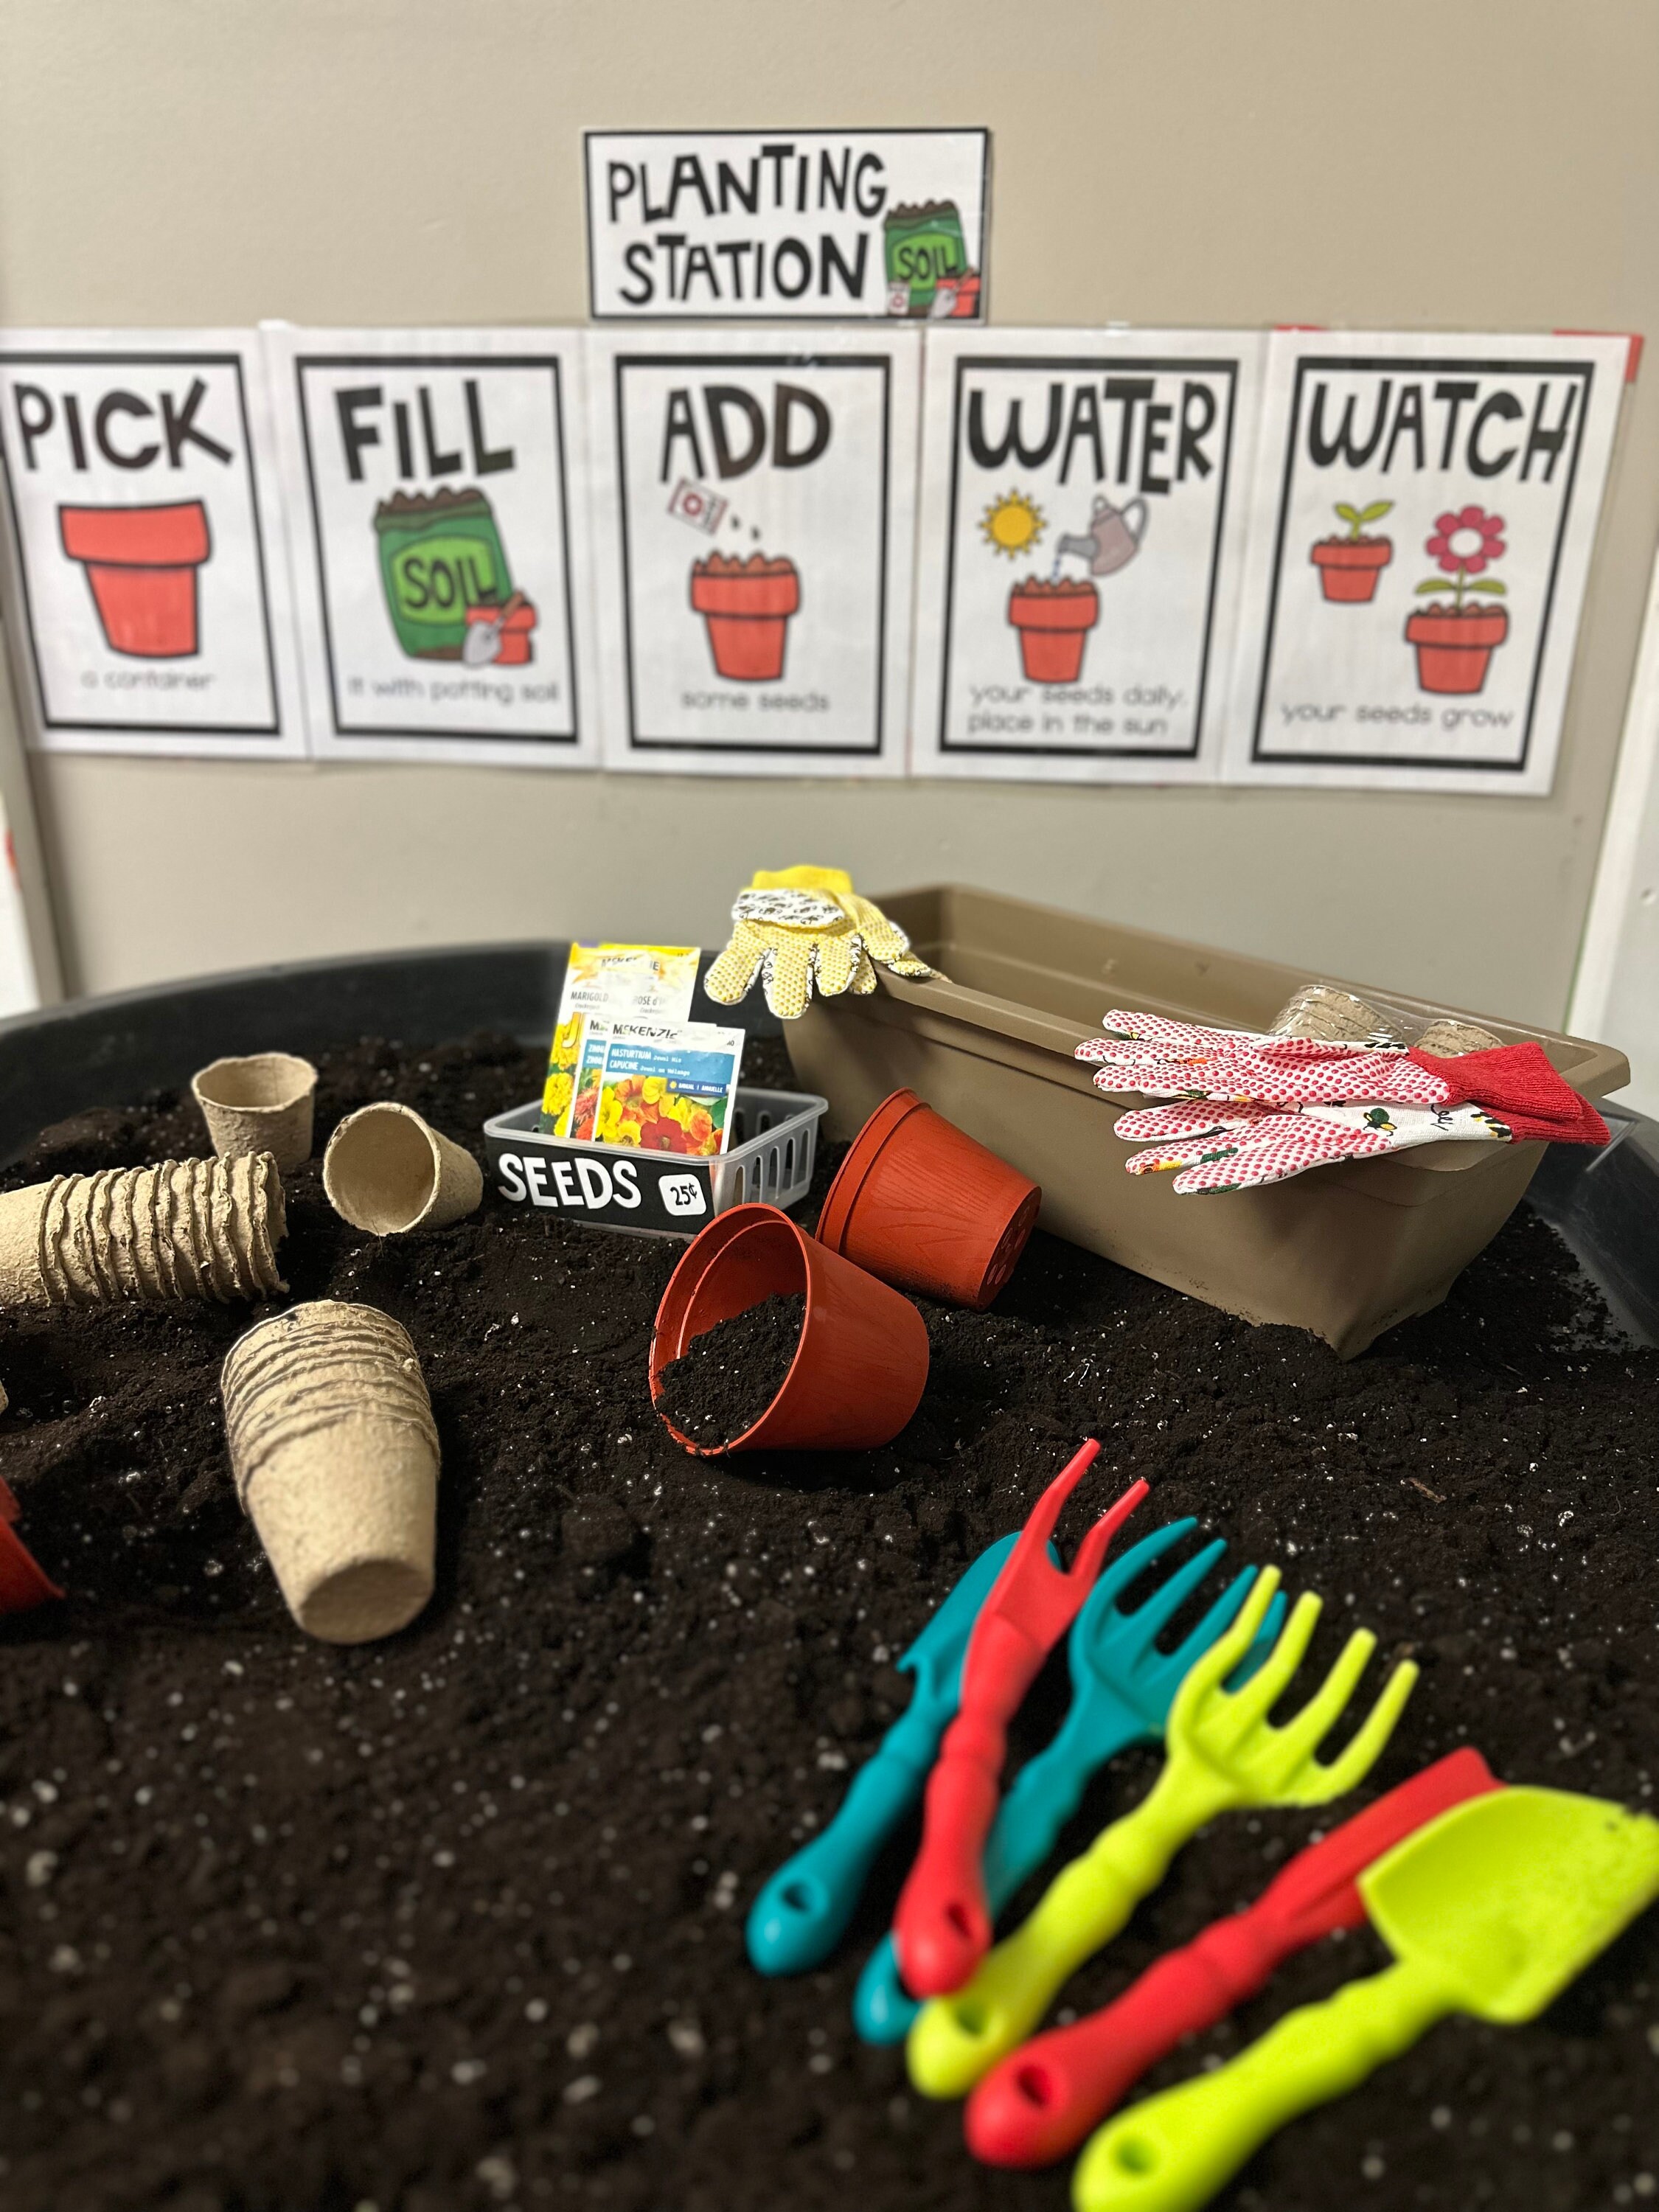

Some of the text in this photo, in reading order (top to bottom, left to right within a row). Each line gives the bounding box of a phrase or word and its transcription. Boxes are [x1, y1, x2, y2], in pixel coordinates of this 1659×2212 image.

[608, 144, 888, 223] PLANTING
[619, 233, 869, 305] STATION
[899, 246, 957, 281] SOIL
[13, 376, 234, 472] PICK
[334, 379, 515, 482] FILL
[661, 382, 832, 484] ADD
[966, 377, 1219, 495] WATER
[1307, 379, 1579, 483] WATCH
[402, 556, 499, 609] SOIL
[758, 690, 830, 711] seeds
[969, 684, 1031, 708] your
[1042, 684, 1114, 705] seeds
[1042, 712, 1064, 732] in
[1074, 713, 1114, 733] the
[1122, 718, 1169, 734] sun
[1280, 703, 1514, 731] your seeds grow
[611, 1048, 652, 1060] NASTURTIUM
[498, 1152, 641, 1209] SEEDS
[670, 1182, 698, 1206] 25¢
